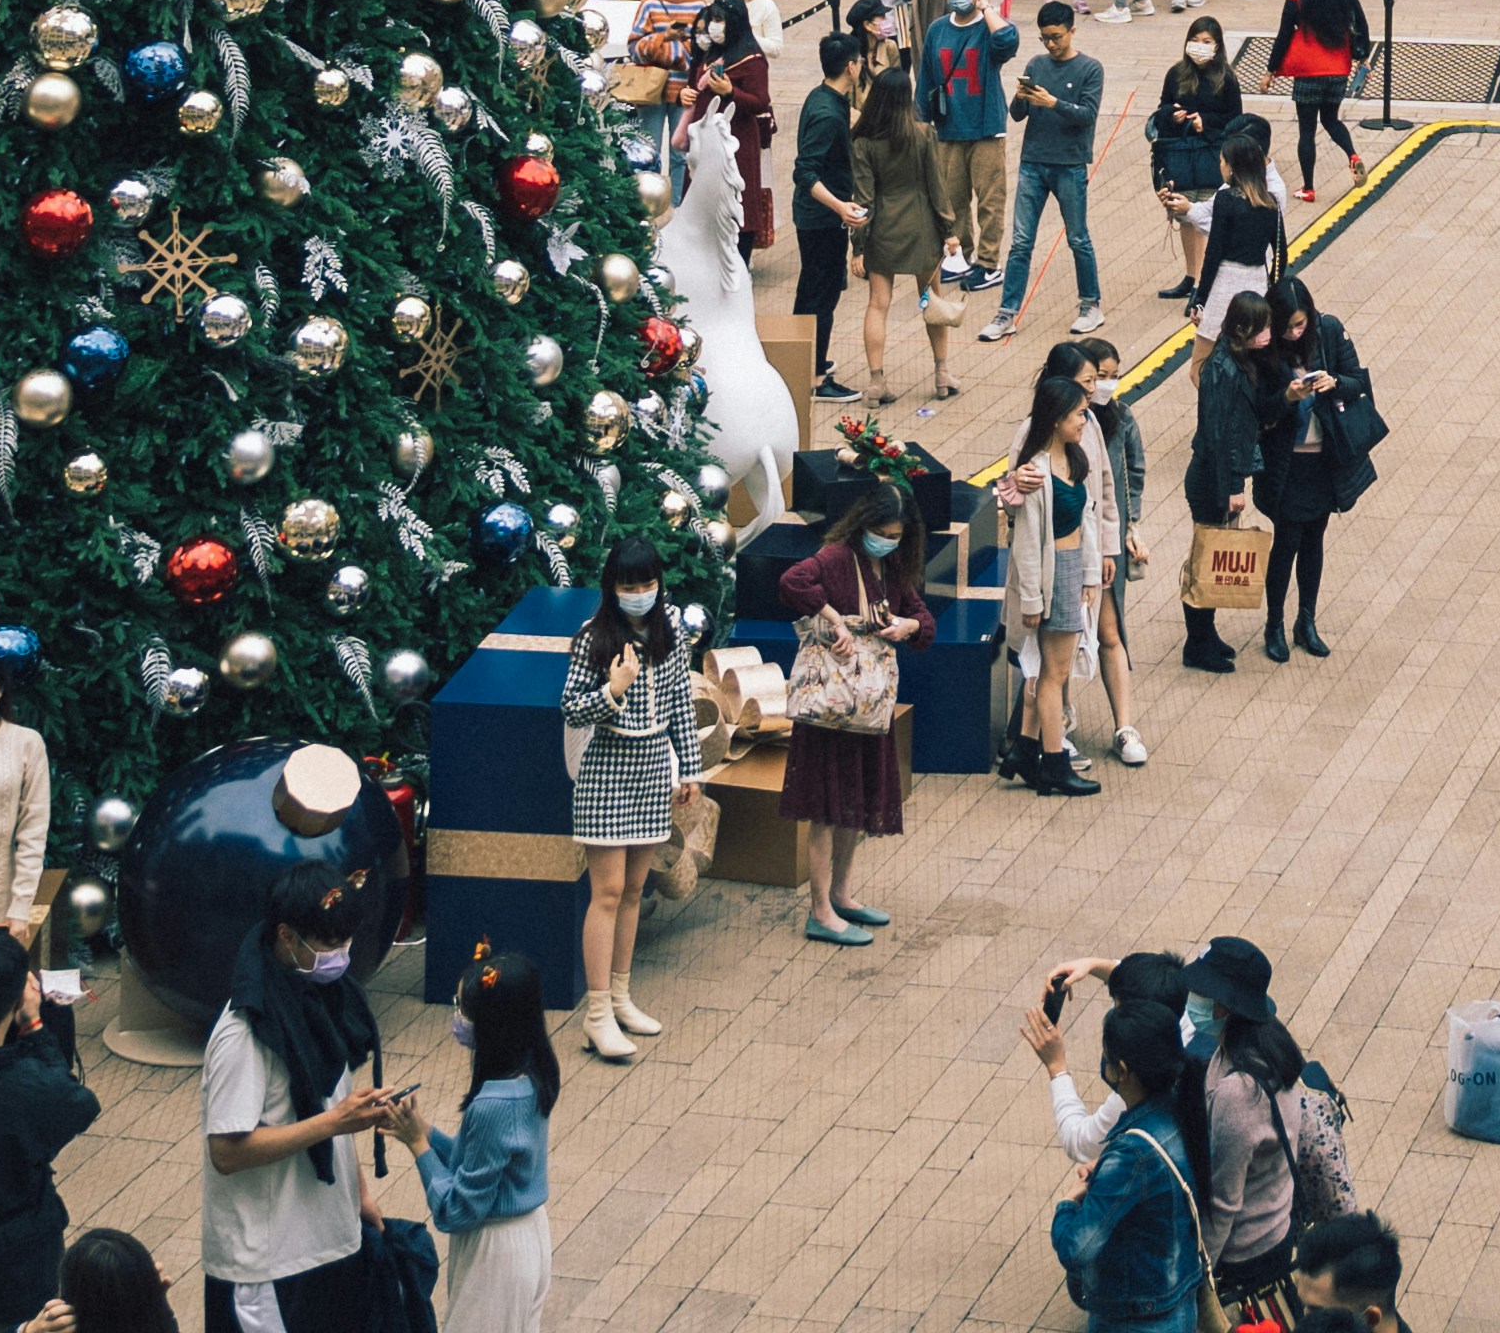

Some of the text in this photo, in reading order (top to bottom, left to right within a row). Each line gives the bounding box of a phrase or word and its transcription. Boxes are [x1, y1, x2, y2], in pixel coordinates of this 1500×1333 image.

[939, 47, 982, 96] H
[1211, 550, 1257, 573] MUJI
[1448, 1068, 1497, 1086] OG-ON
